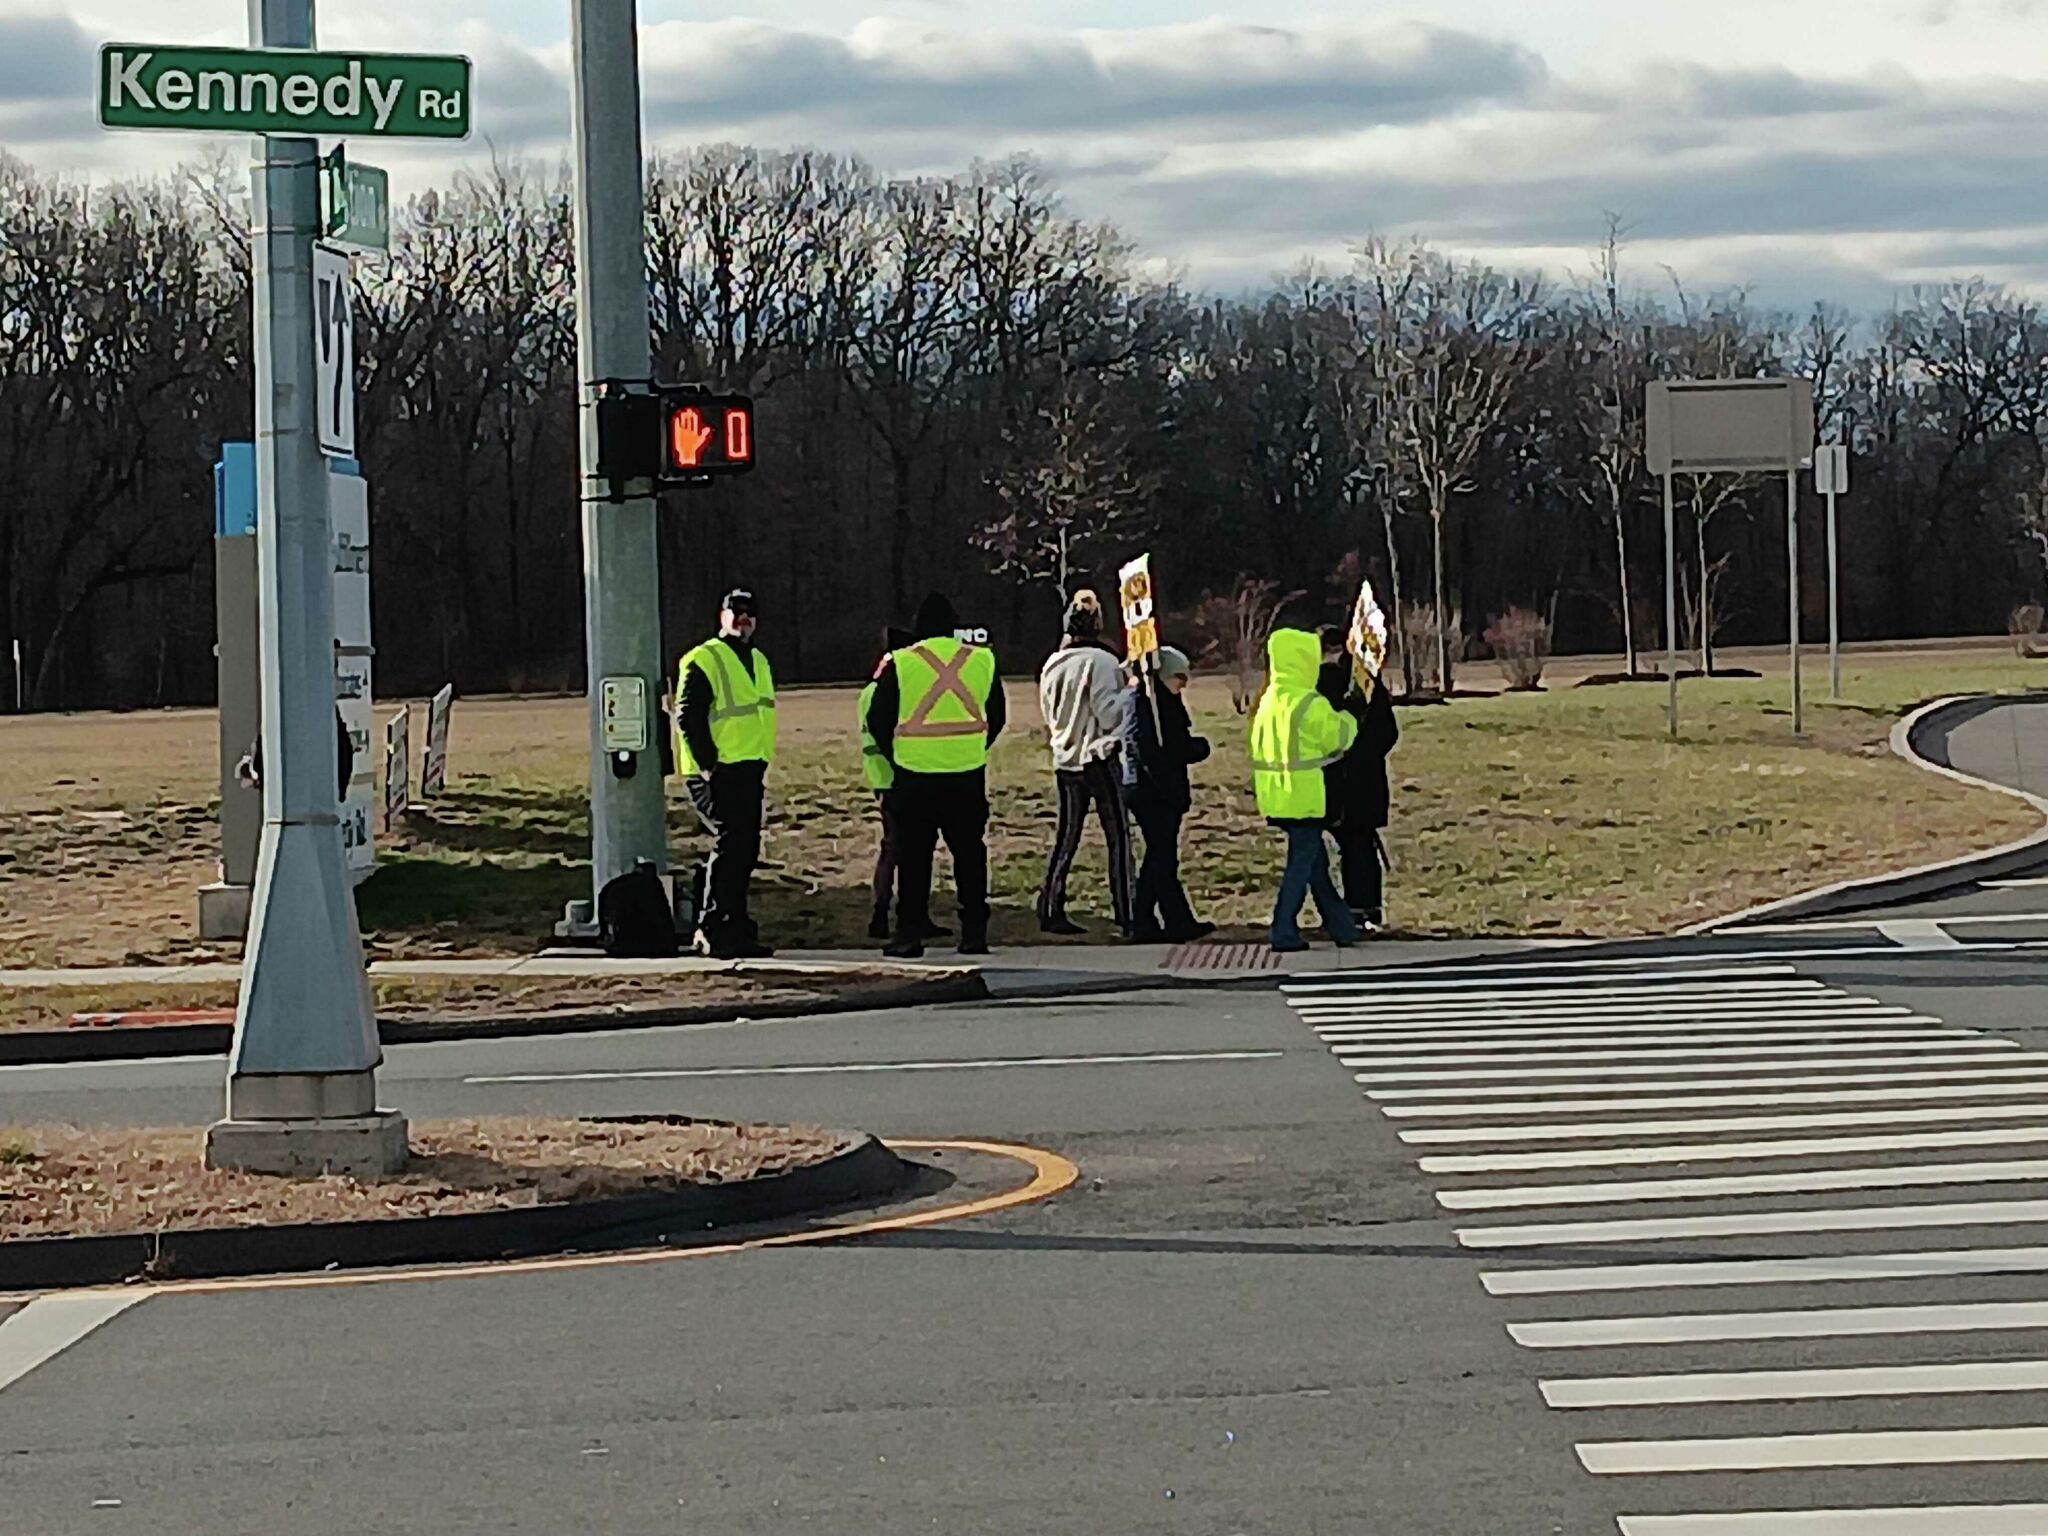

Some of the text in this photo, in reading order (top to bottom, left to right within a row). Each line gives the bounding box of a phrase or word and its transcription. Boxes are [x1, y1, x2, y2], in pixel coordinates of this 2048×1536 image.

[109, 52, 461, 130] Kennedy Rd
[727, 410, 748, 458] 0
